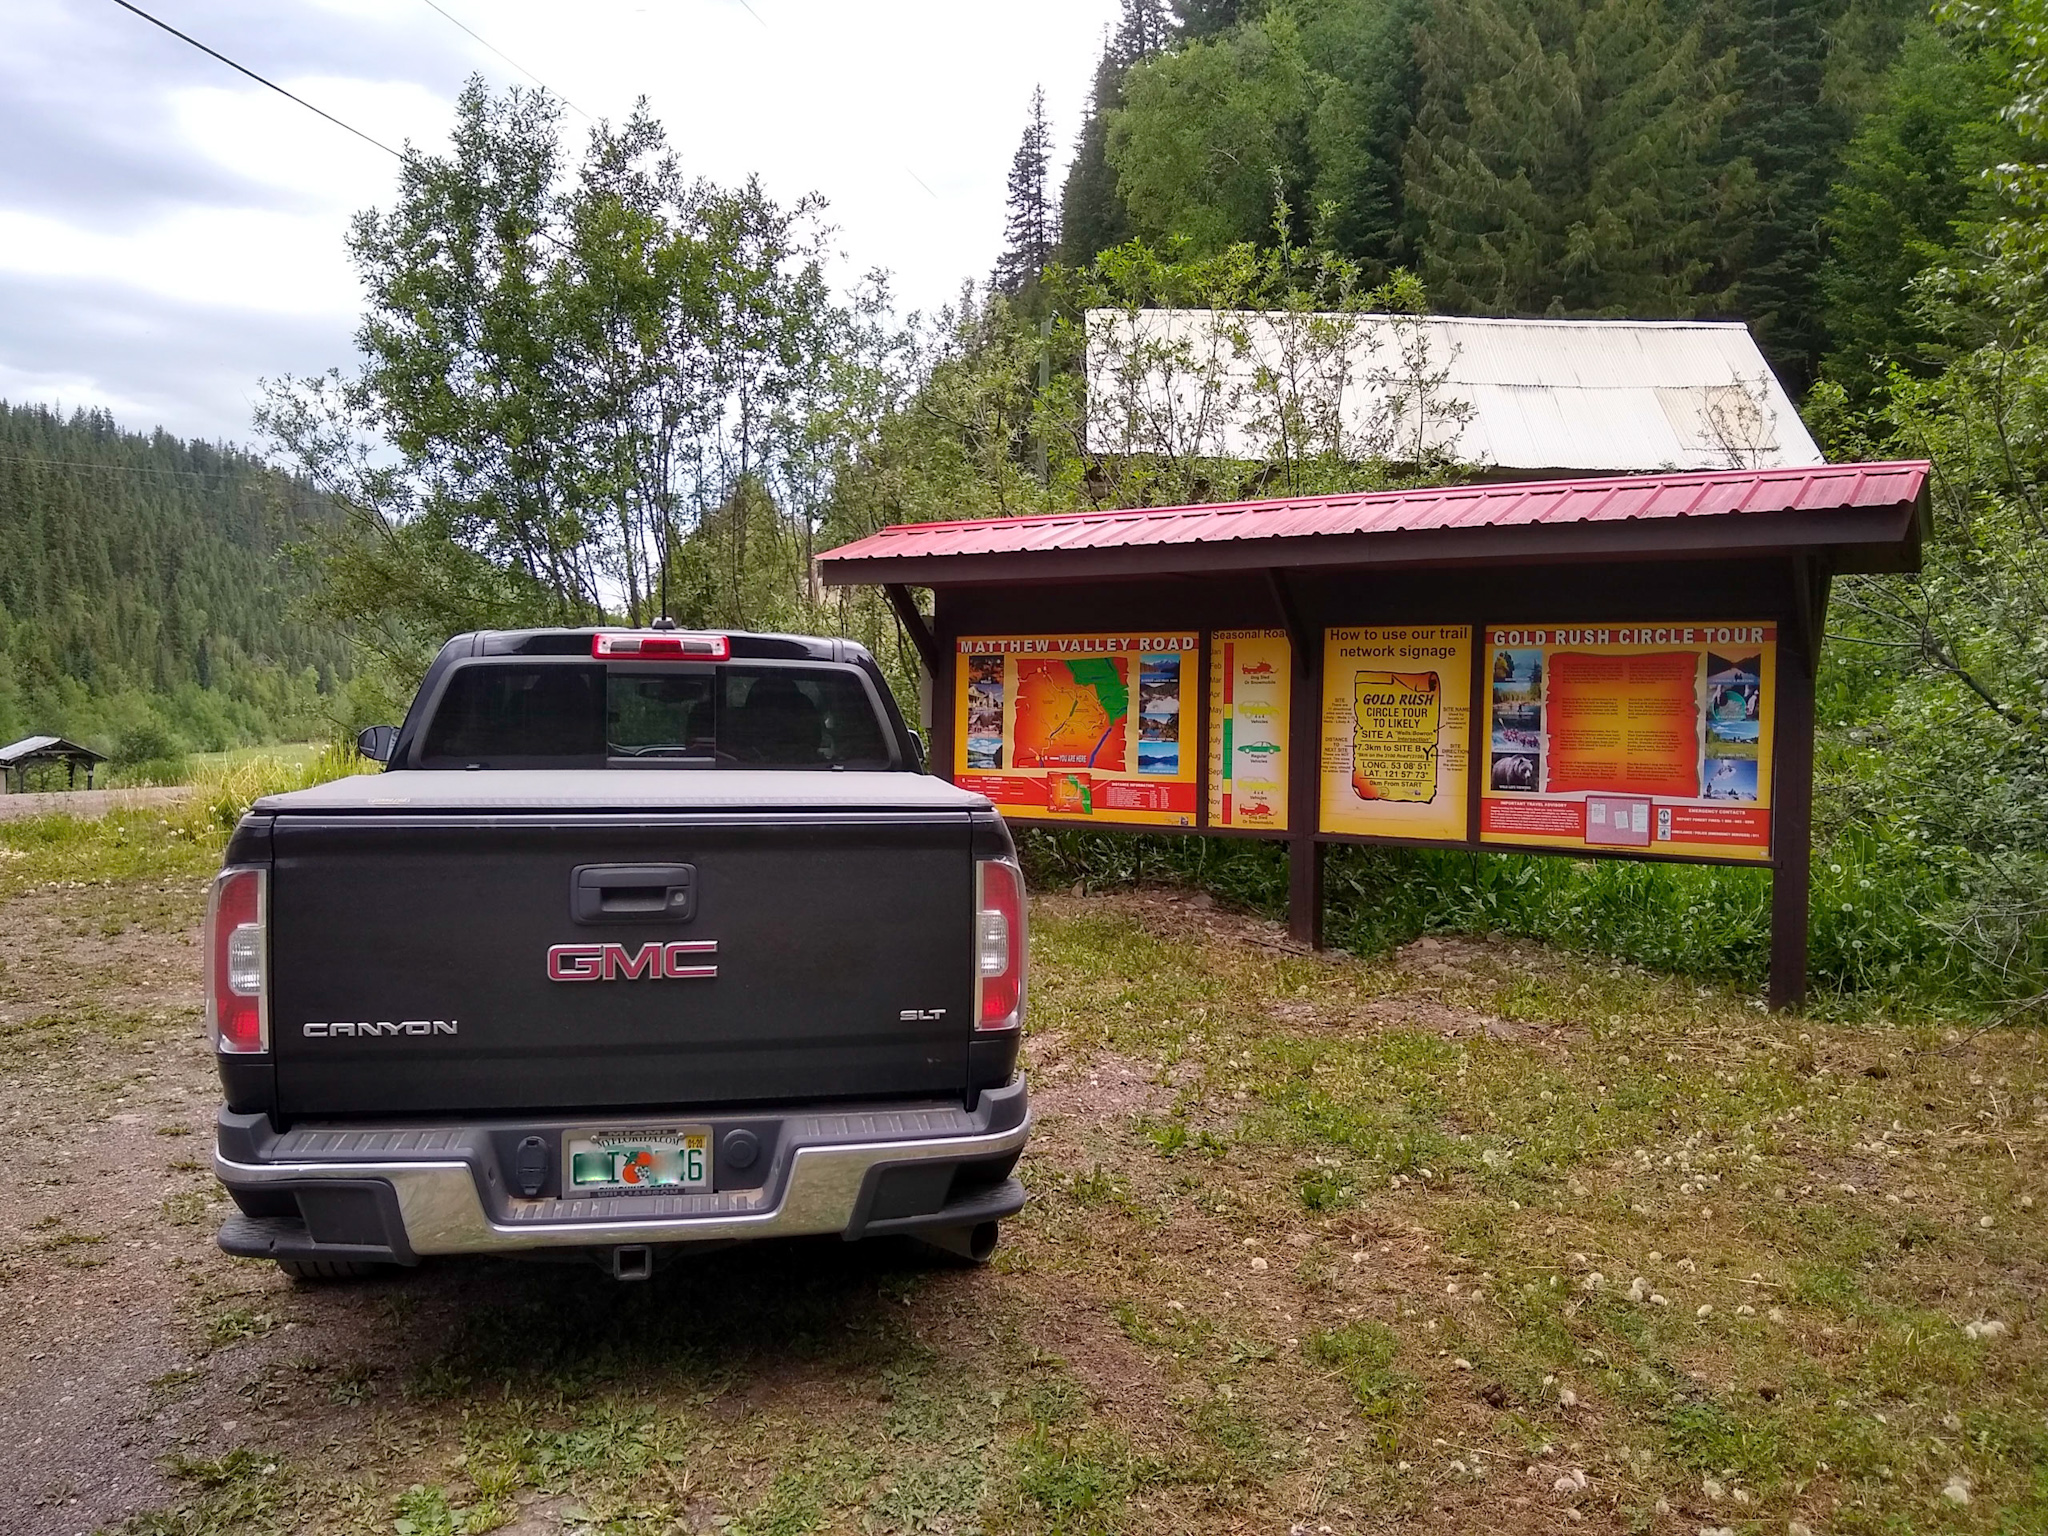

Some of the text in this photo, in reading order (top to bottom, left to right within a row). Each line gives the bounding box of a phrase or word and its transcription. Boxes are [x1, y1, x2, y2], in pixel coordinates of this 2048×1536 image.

[1212, 629, 1286, 640] Seasonal Roa
[1330, 627, 1468, 640] How to use our trail
[1494, 627, 1764, 646] GOLD RUSH CIRCLE TOUR
[960, 636, 1194, 653] MATTHEW VALLEY ROAD
[1340, 644, 1457, 659] network signage
[1363, 693, 1435, 706] GOLD RUSH
[1366, 707, 1428, 718] CIRCLE TOUR
[1373, 718, 1421, 729] TO LIKELY
[1361, 730, 1383, 739] SITE
[1386, 730, 1394, 739] A
[1357, 743, 1382, 751] 7.3km
[1393, 744, 1413, 752] SITE
[1059, 754, 1087, 763] YOU ARE HERE
[1362, 761, 1389, 769] LONG.
[1363, 769, 1382, 777] LAT.
[547, 940, 719, 982] GMC
[900, 1009, 947, 1021] SLT
[303, 1020, 458, 1037] CANYON
[597, 1135, 680, 1149] MYFLORIDA.COM
[597, 1189, 679, 1198] WILLIAMSON
